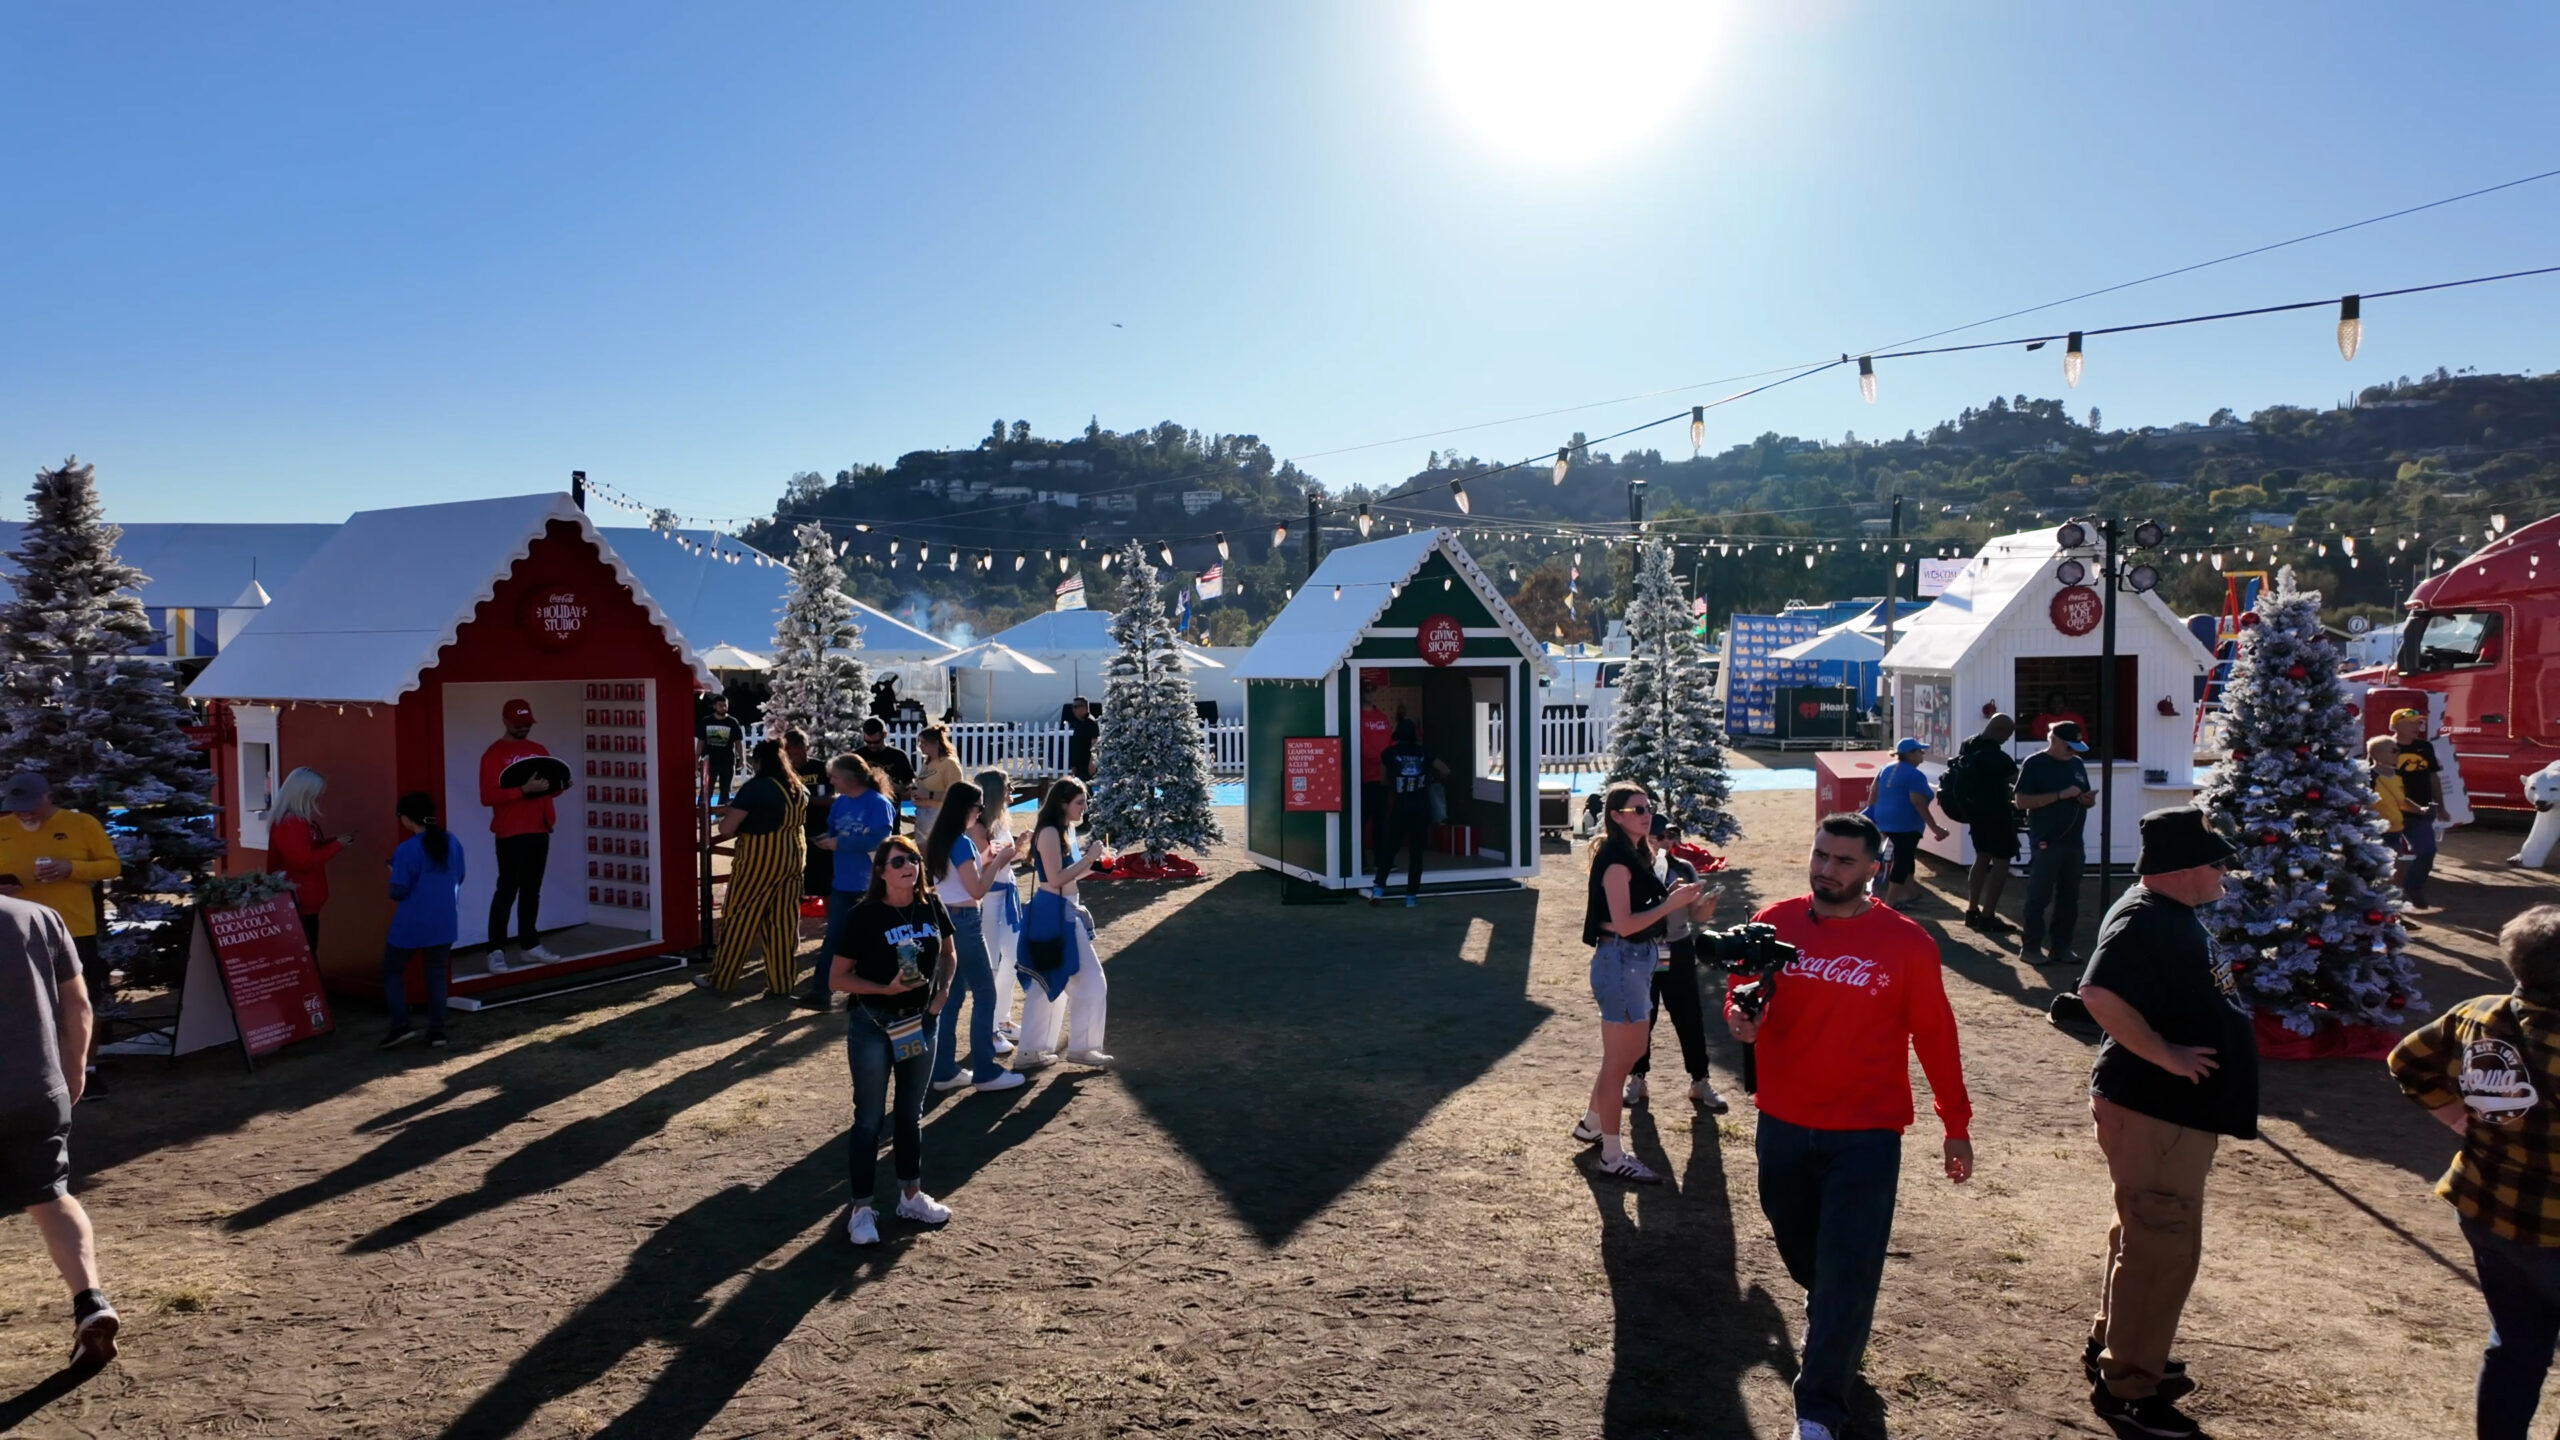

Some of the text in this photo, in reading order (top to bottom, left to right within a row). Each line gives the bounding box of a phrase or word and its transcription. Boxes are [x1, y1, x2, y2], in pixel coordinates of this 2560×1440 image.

[543, 604, 580, 619] HOLIDAY
[544, 618, 581, 631] STUDIO
[1430, 629, 1458, 641] GIVING
[1428, 641, 1460, 652] SHOPPE
[210, 910, 236, 924] PICK
[248, 902, 276, 917] YOUR
[217, 924, 281, 947] HOLIDAY CAN
[884, 922, 939, 945] UCLA
